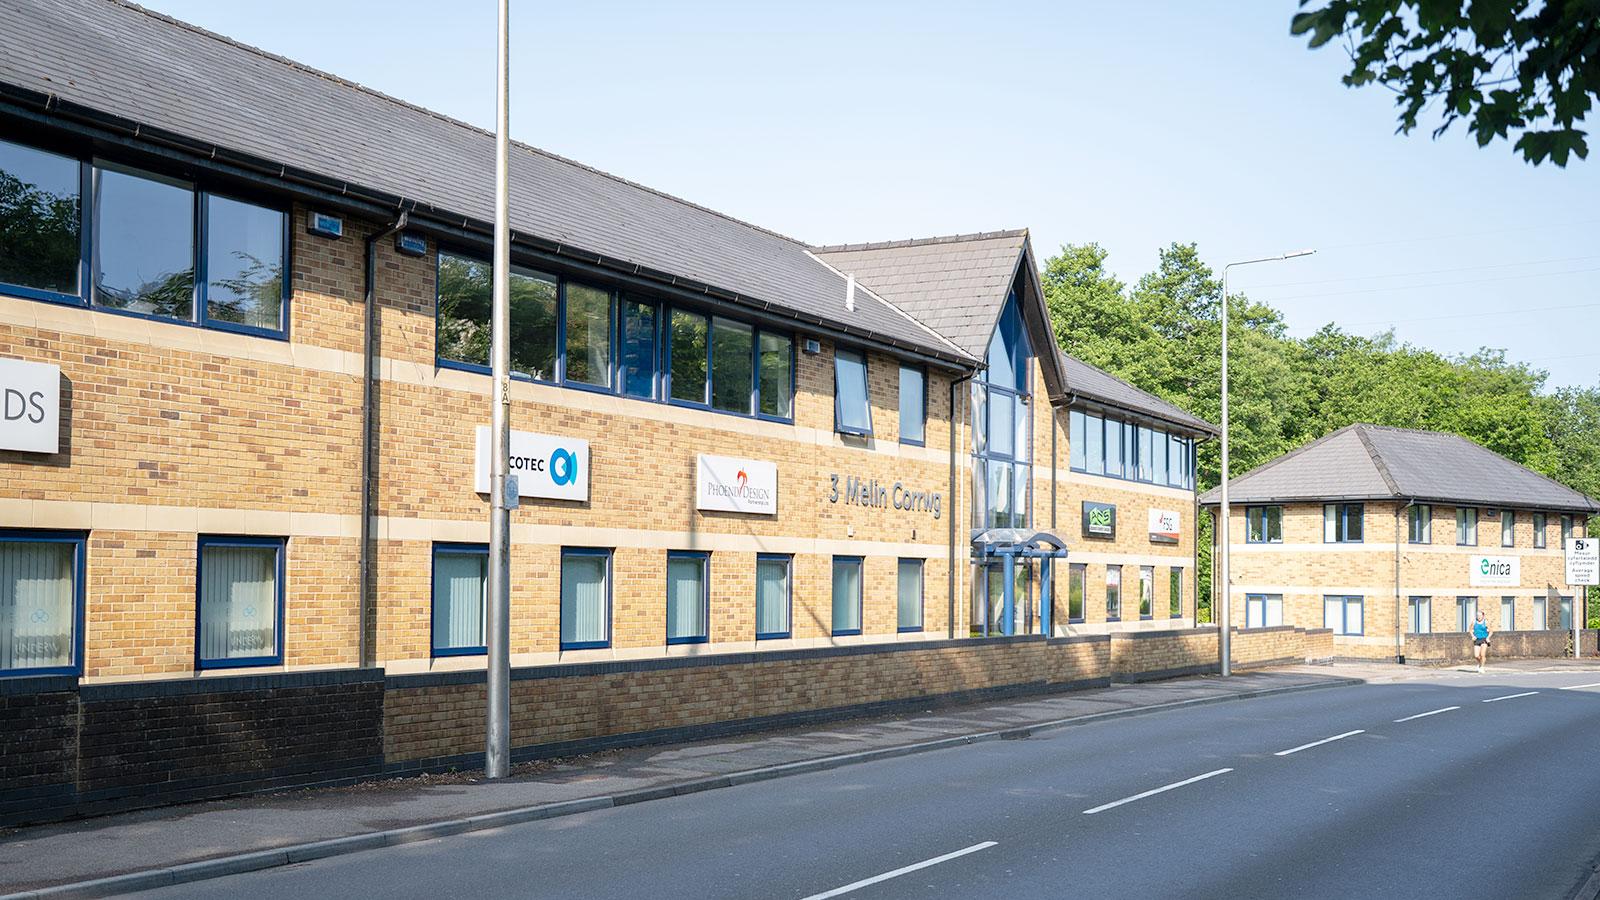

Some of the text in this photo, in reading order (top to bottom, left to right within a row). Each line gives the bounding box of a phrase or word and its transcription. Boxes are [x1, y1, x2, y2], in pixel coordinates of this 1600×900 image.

[4, 388, 45, 424] DS
[743, 485, 770, 500] DESIGN
[830, 474, 941, 519] 3 Melin Corrwg
[1481, 558, 1511, 575] enica
